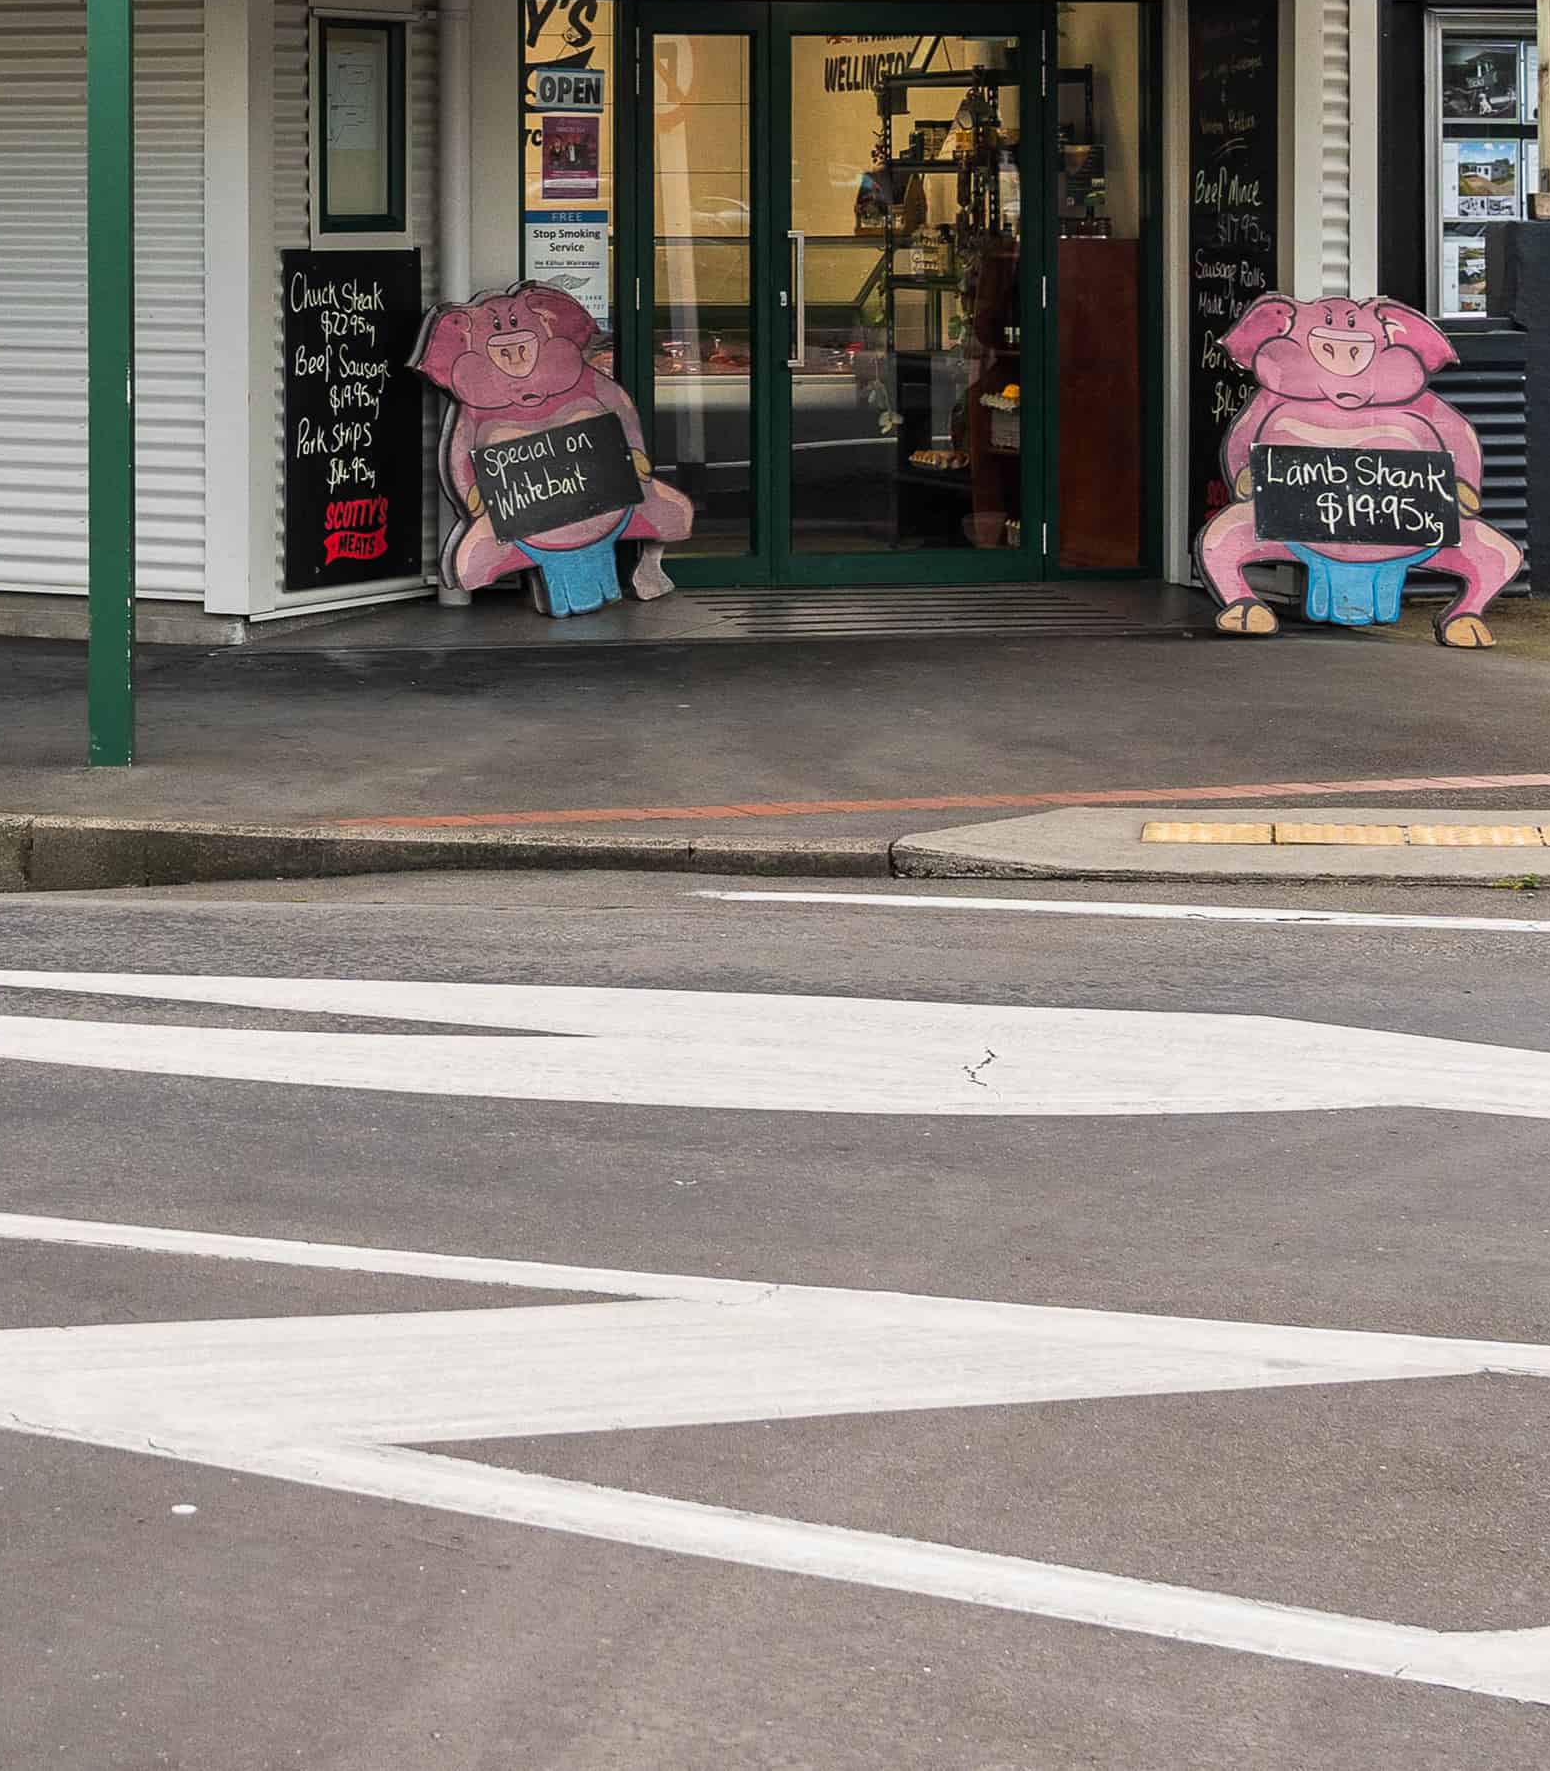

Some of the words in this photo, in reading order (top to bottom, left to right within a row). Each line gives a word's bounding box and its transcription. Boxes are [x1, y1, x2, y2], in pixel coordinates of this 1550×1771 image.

[539, 77, 600, 105] OPEN
[1194, 165, 1227, 210] Beef
[533, 230, 557, 240] Stop
[559, 229, 601, 240] Smoking
[551, 213, 583, 222] FREE
[549, 242, 585, 252] Service
[290, 271, 340, 313] Chuck
[341, 279, 385, 313] Steak
[294, 344, 334, 382] Beef
[339, 343, 391, 394] Sausage
[296, 417, 328, 459] Pork
[330, 421, 373, 454] Strips
[483, 433, 556, 490] Special
[566, 432, 593, 453] on
[1267, 447, 1348, 486] Lamb
[1355, 456, 1454, 501] Shank
[494, 461, 588, 521] Whitebait
[325, 496, 389, 531] SCOTTY'S
[337, 536, 376, 557] MEATS
